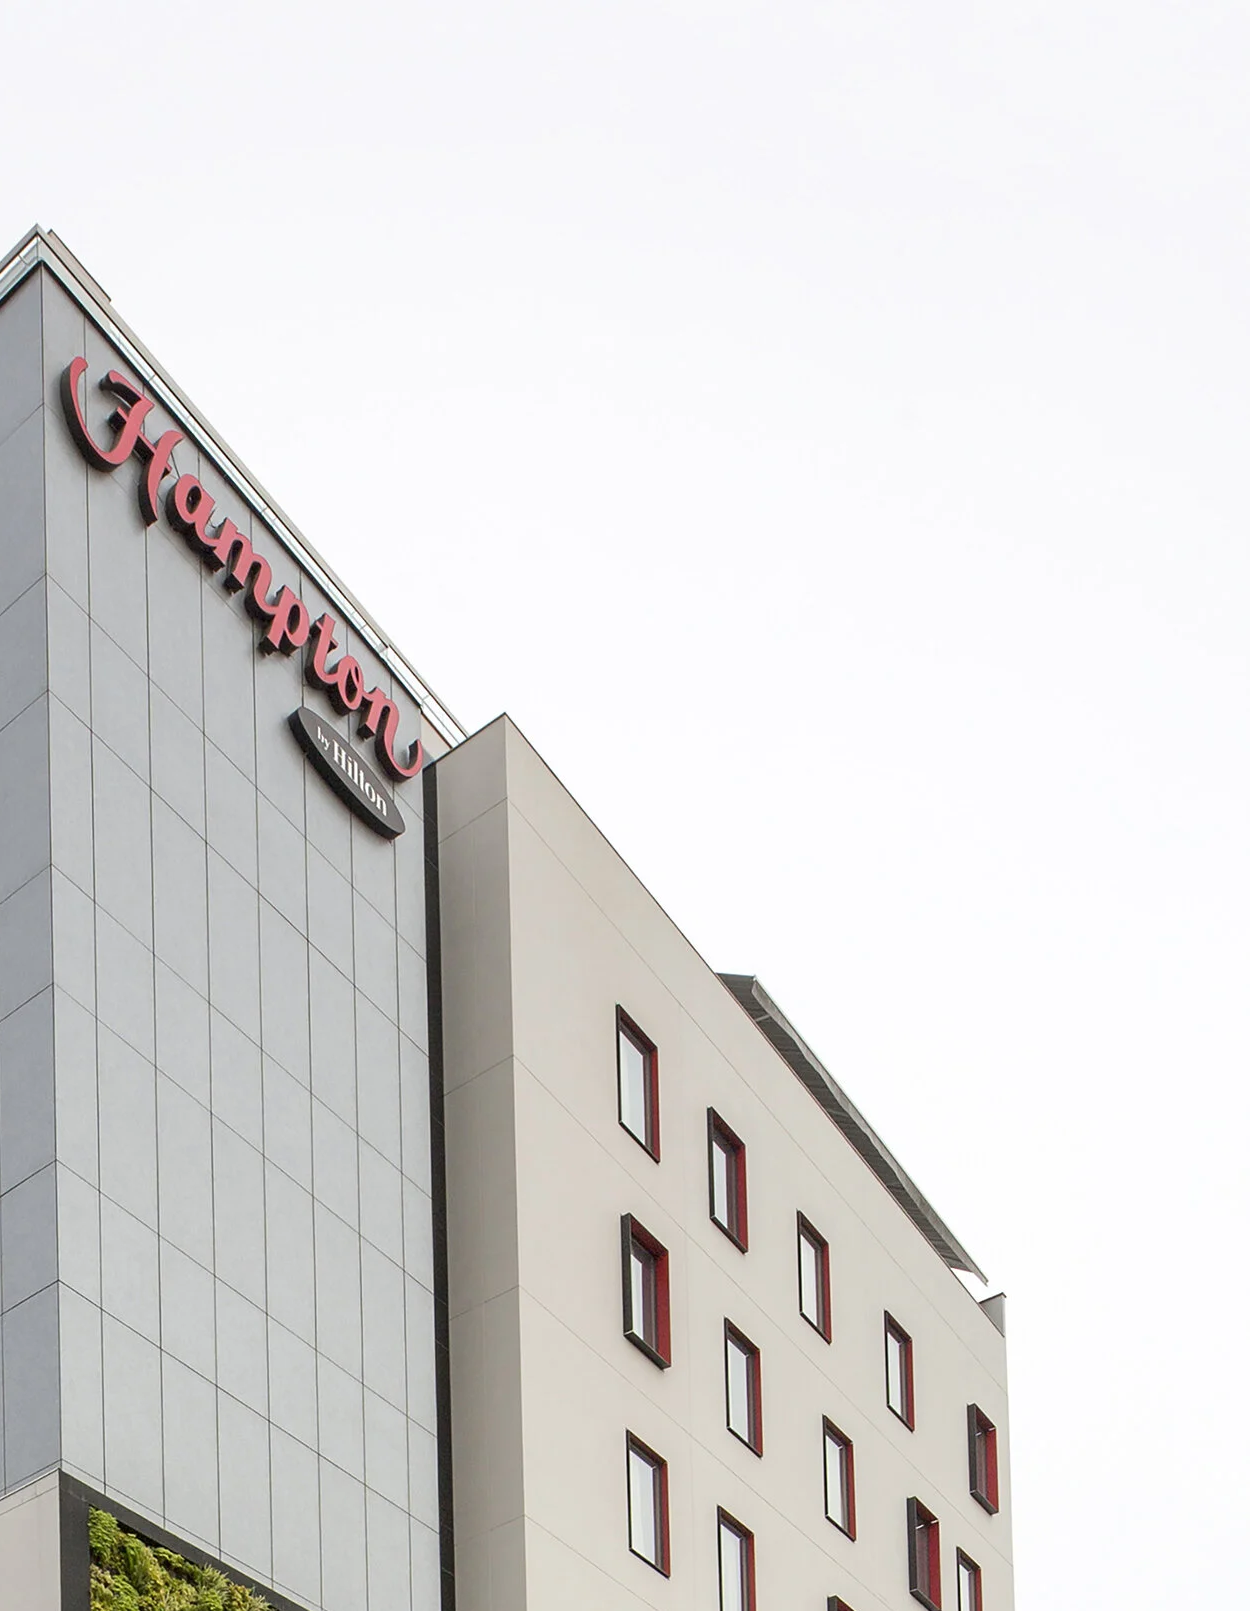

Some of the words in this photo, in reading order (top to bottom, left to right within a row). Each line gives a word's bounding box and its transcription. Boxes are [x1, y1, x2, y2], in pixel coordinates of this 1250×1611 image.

[61, 356, 424, 780] Hampton
[317, 726, 330, 751] by
[333, 738, 387, 817] Hilton
